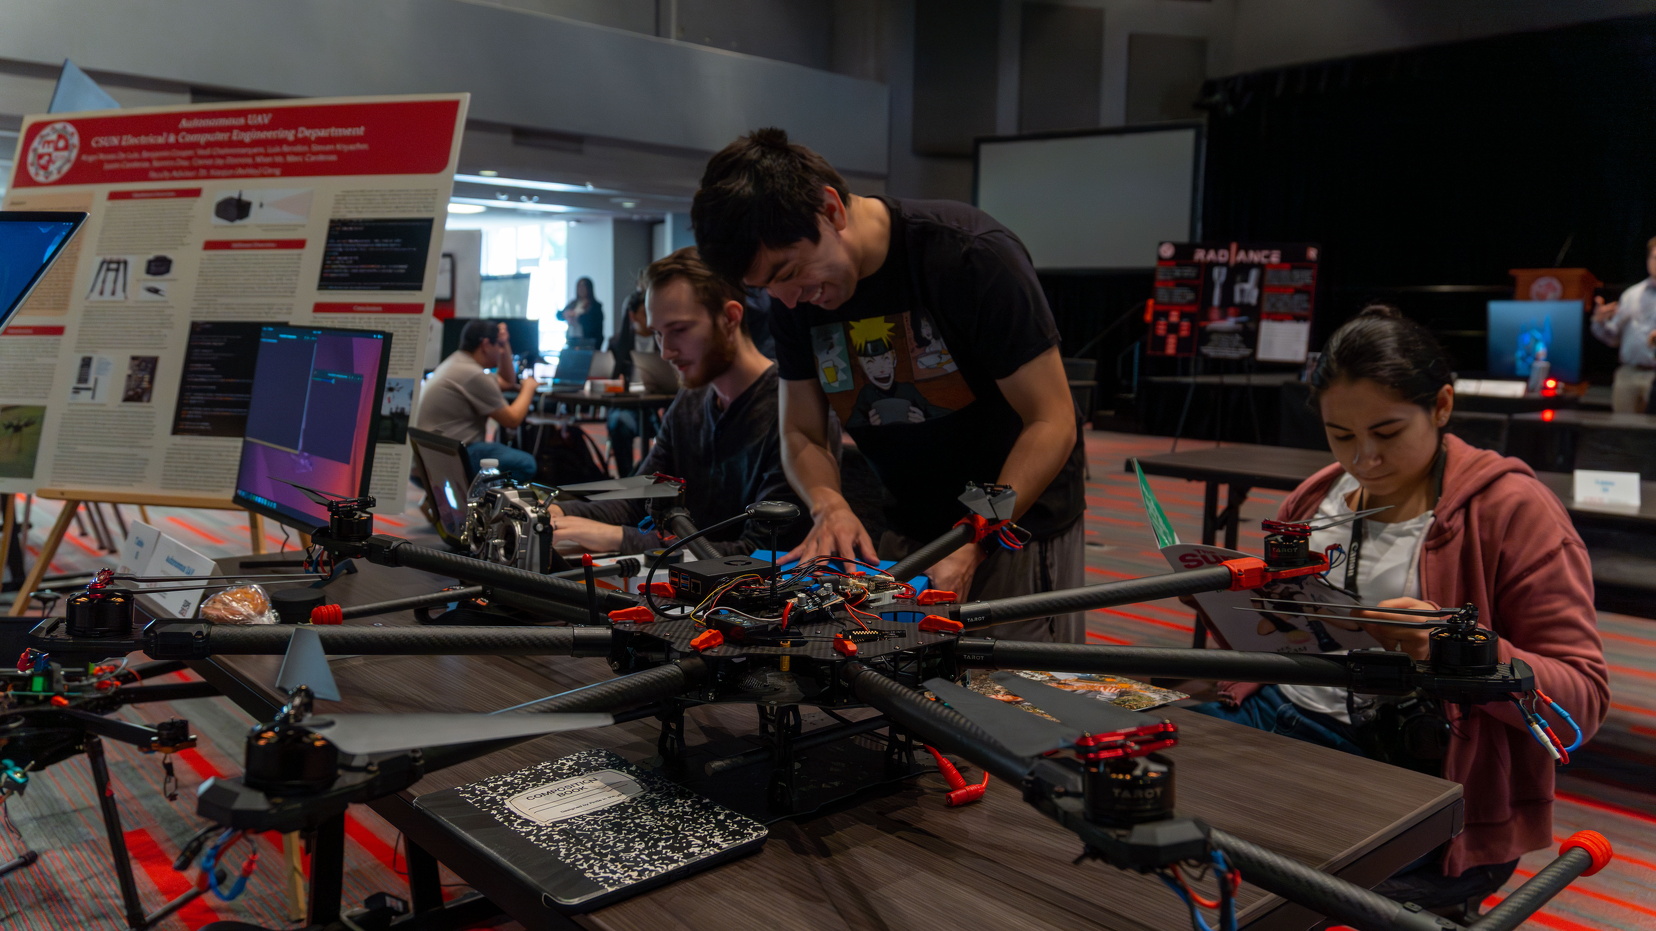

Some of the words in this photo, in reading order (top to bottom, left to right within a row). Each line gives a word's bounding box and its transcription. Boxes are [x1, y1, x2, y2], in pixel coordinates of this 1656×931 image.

[178, 117, 245, 128] Autonomous
[247, 113, 272, 126] UAV
[90, 135, 119, 148] CSUN
[120, 132, 166, 146] Electrical
[167, 132, 177, 144] &
[178, 131, 230, 145] Computer
[231, 127, 296, 143] Engineering
[297, 126, 365, 141] Department
[1193, 242, 1282, 266] RADIANCE
[1347, 541, 1359, 577] Canon
[526, 777, 598, 801] COMPOSITION
[557, 786, 588, 797] BOOK
[1112, 787, 1164, 799] TAROT
